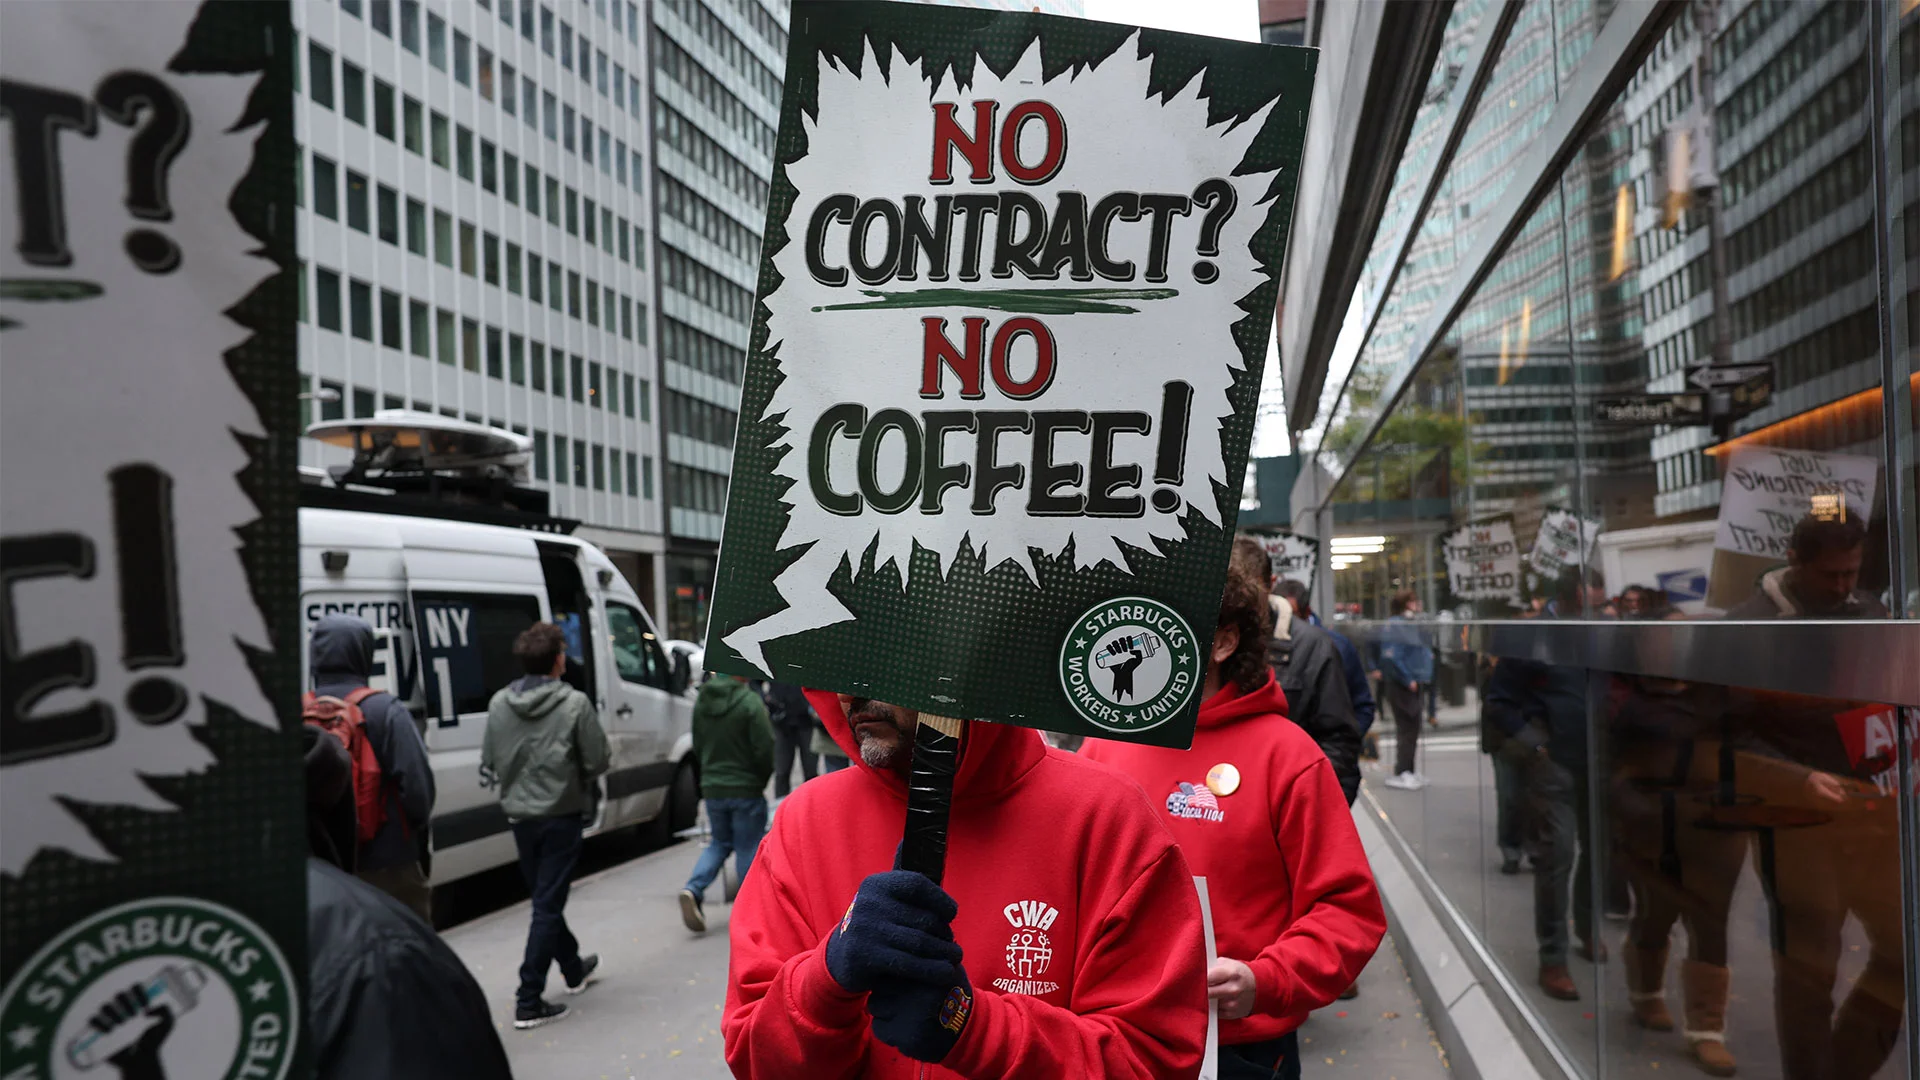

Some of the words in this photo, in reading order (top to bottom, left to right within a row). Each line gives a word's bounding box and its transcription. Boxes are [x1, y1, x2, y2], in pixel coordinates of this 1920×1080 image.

[928, 99, 1067, 185] NO
[805, 177, 1237, 286] CONTRACT?
[919, 316, 1057, 400] NO
[808, 380, 1194, 518] COFFEE!
[425, 607, 470, 648] NY
[1085, 605, 1188, 649] STARBUCKS
[432, 657, 454, 722] 1
[1068, 656, 1120, 723] WORKERS
[1140, 671, 1190, 721] UNITED
[1203, 808, 1224, 822] 1104
[1003, 900, 1059, 931] CWA
[27, 914, 260, 1011] STARBUCKS
[992, 978, 1059, 995] ORGANIZER
